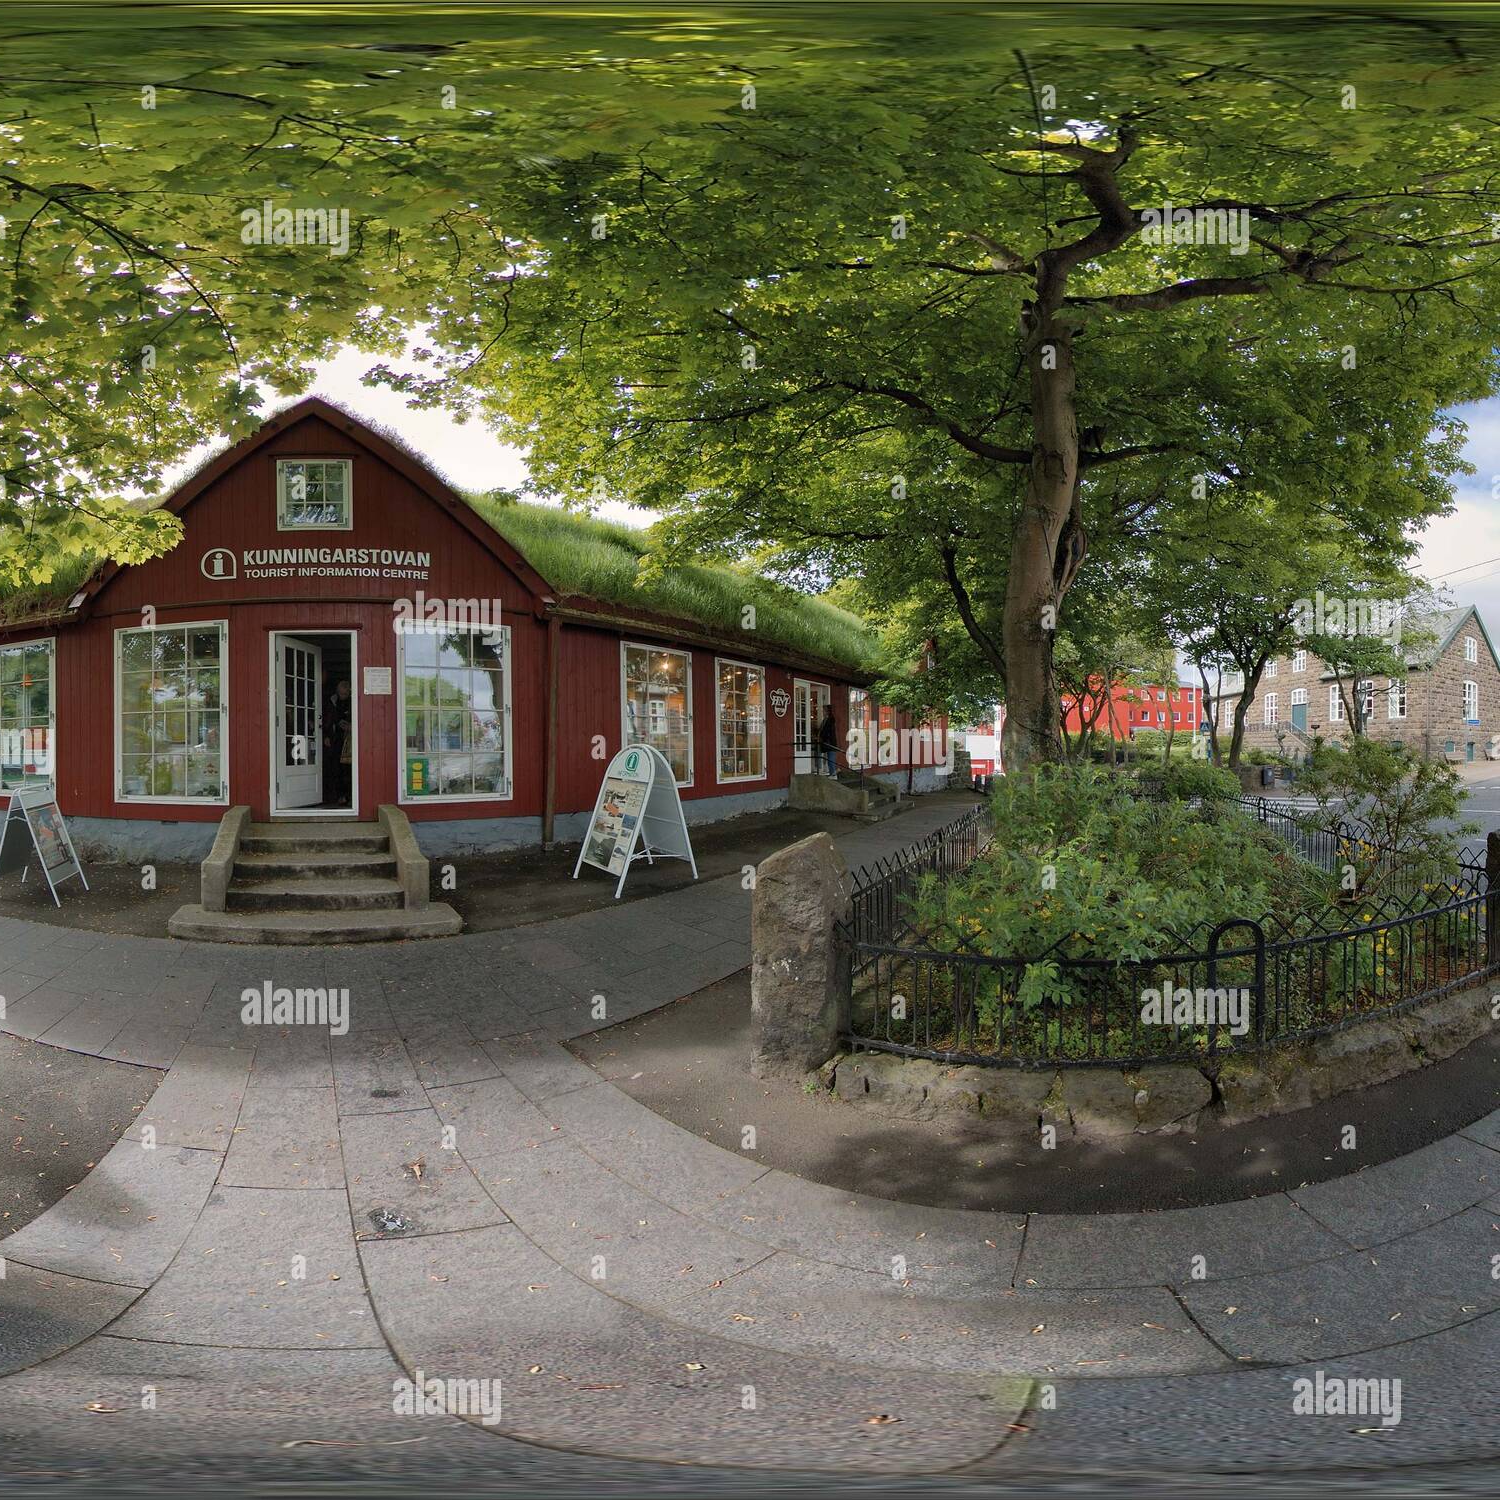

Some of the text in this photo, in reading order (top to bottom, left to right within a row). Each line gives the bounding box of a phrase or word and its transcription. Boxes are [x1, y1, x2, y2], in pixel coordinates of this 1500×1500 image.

[243, 548, 431, 568] KUNNINGARSTOVAN
[244, 567, 429, 580] TOURIST INFORMATION CENTRE
